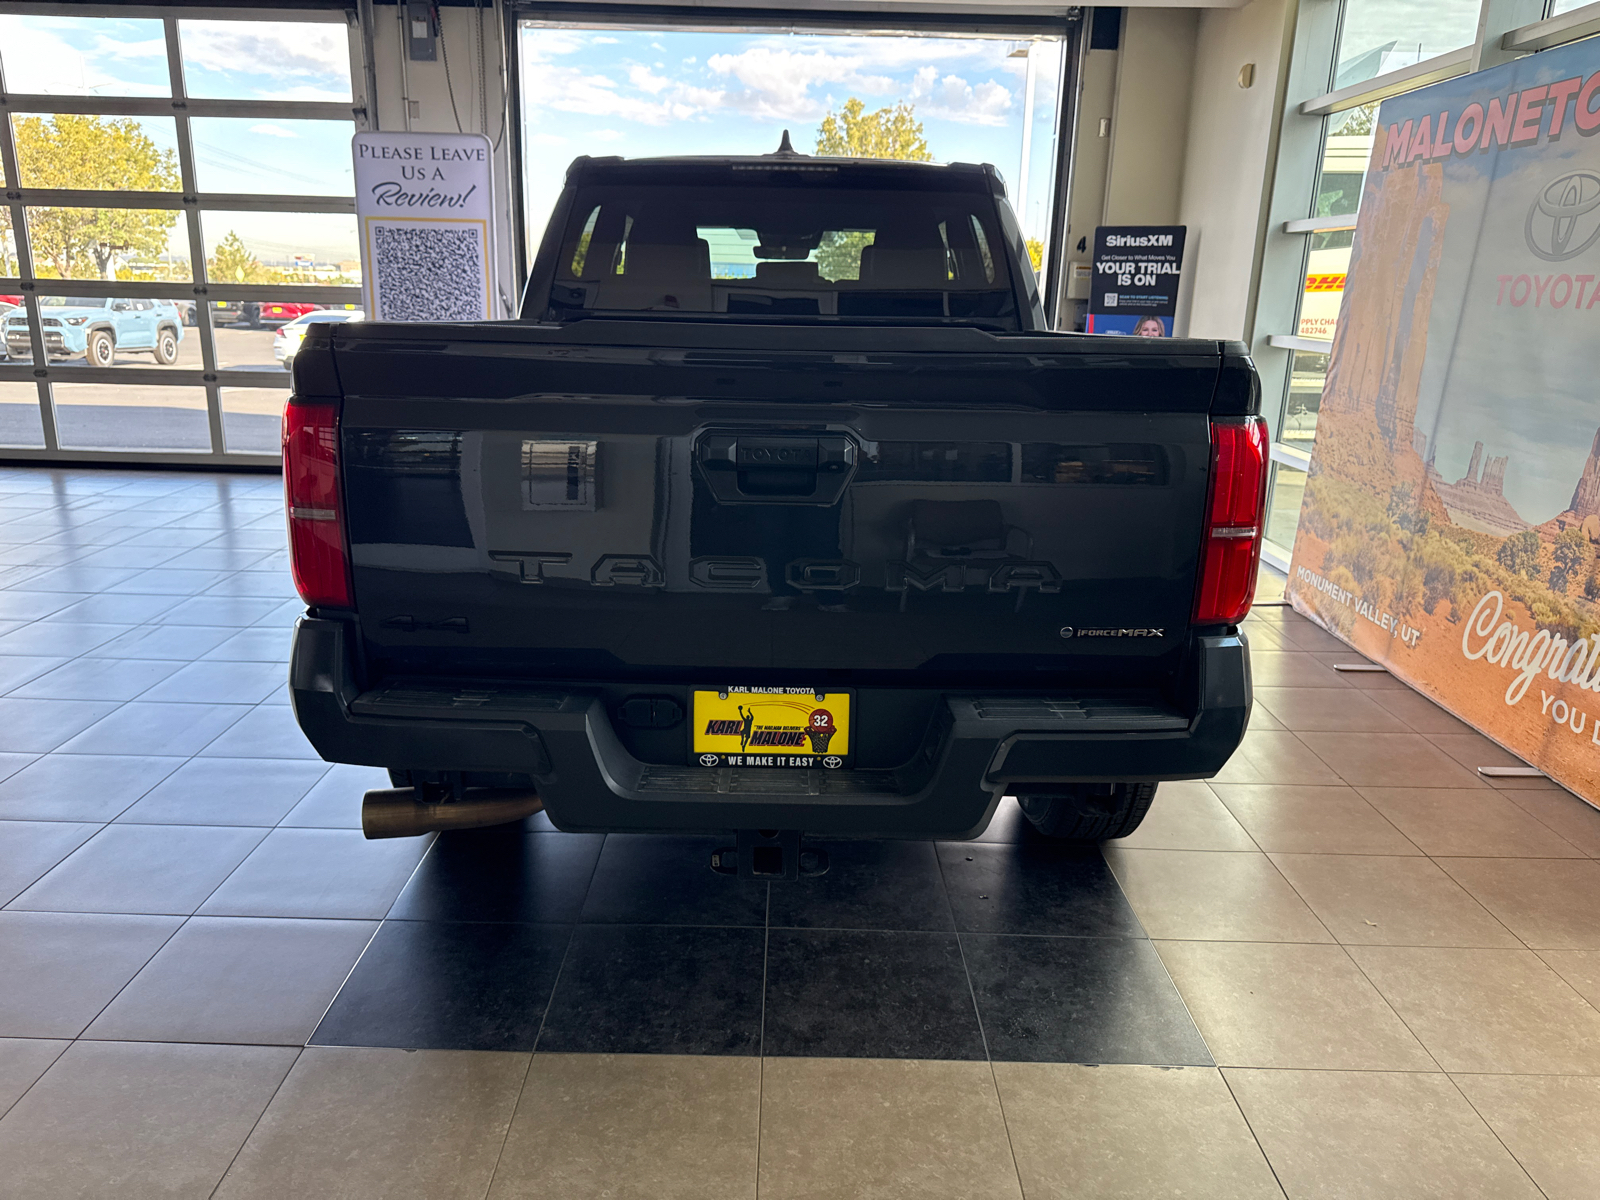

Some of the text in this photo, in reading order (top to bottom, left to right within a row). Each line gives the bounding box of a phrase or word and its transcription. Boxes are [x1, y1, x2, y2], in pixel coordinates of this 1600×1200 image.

[359, 144, 485, 161] PLEASE LEAVE
[401, 166, 445, 181] US A
[371, 181, 477, 208] Review!
[1076, 236, 1087, 254] 4
[1106, 234, 1173, 247] SiriusXM
[1096, 262, 1135, 274] YOUR
[1138, 262, 1181, 275] TRIAL
[1117, 274, 1157, 287] IS ON
[740, 447, 813, 461] TOYOTA
[488, 549, 1063, 593] TACOMA
[1296, 565, 1420, 646] MONUMENT VALLEY, UT
[1462, 590, 1600, 706] Congrat
[727, 685, 816, 695] KARL MALONE TOYOTA
[1541, 690, 1586, 734] YOU
[705, 719, 744, 735] KARL
[813, 715, 829, 727] 32
[749, 730, 807, 747] MALONE
[727, 756, 814, 767] WE MAKE IT EASY
